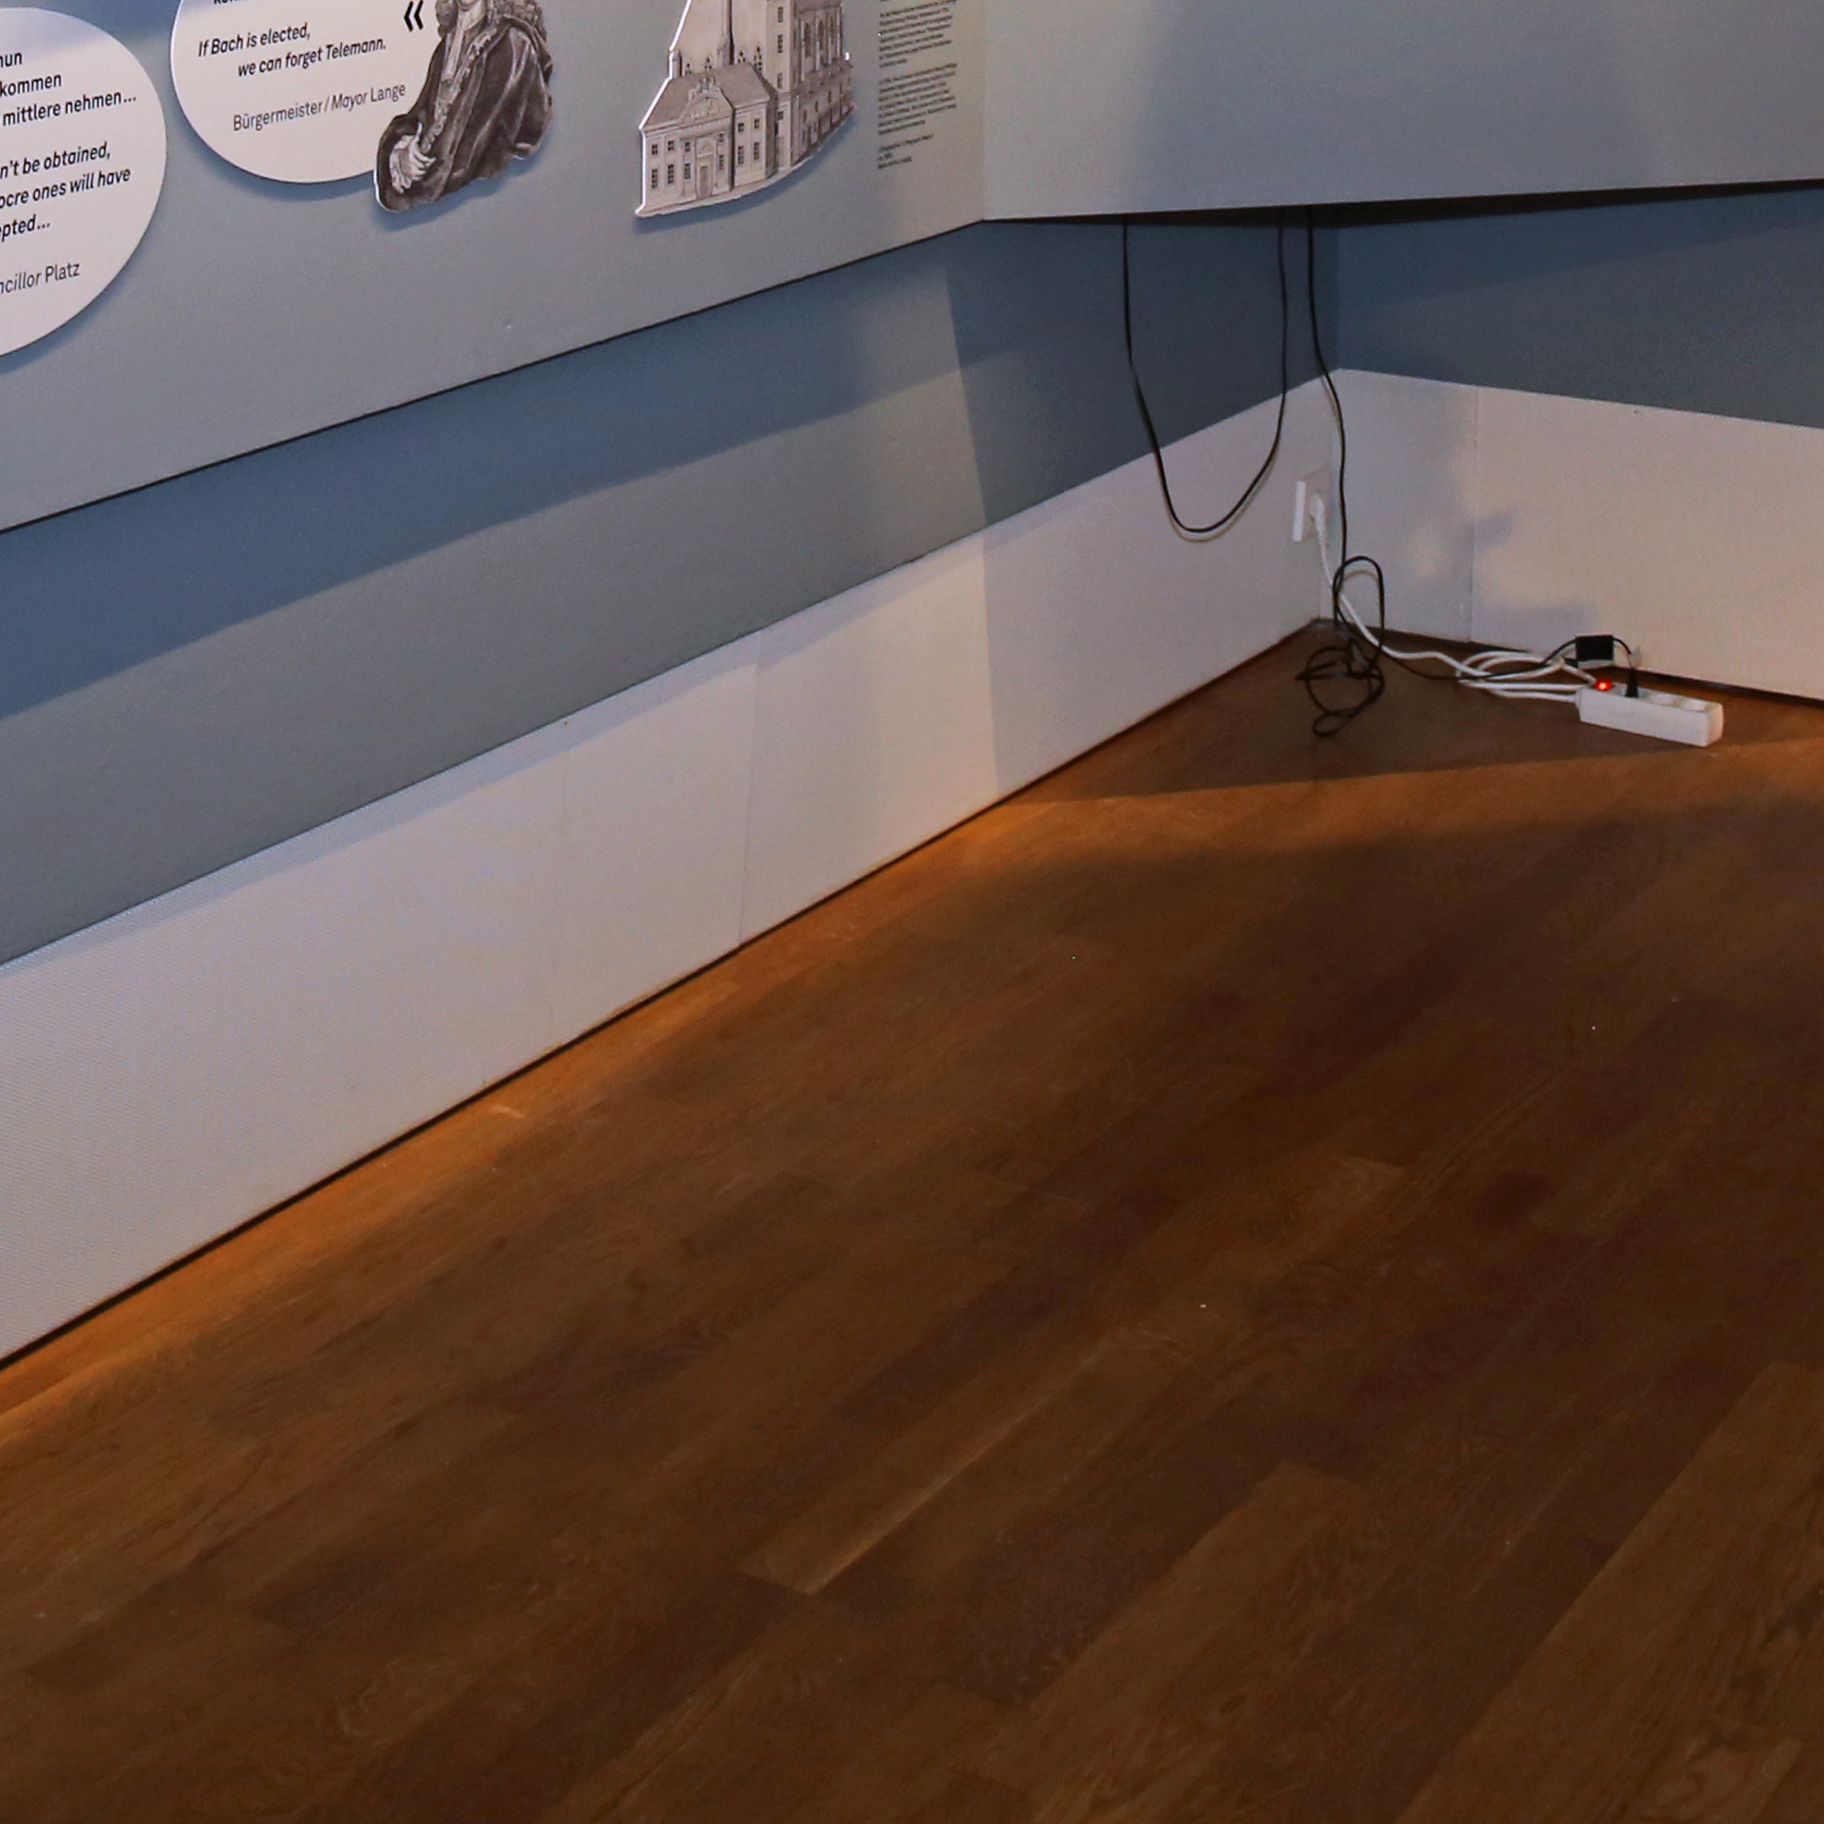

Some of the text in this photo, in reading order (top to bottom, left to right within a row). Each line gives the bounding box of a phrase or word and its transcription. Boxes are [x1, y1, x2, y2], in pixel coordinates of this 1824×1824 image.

[198, 24, 311, 56] If Bach is elected,
[238, 37, 386, 77] we can forget Telemann.
[2, 99, 61, 127] mittlere
[232, 101, 324, 131] Bürgermeister
[331, 91, 366, 116] Mayor
[370, 83, 405, 106] Lange
[24, 156, 40, 176] be
[44, 142, 111, 173] obtained,
[33, 181, 67, 202] ones
[71, 173, 95, 196] will
[98, 167, 131, 189] have
[45, 261, 80, 284] Platz
